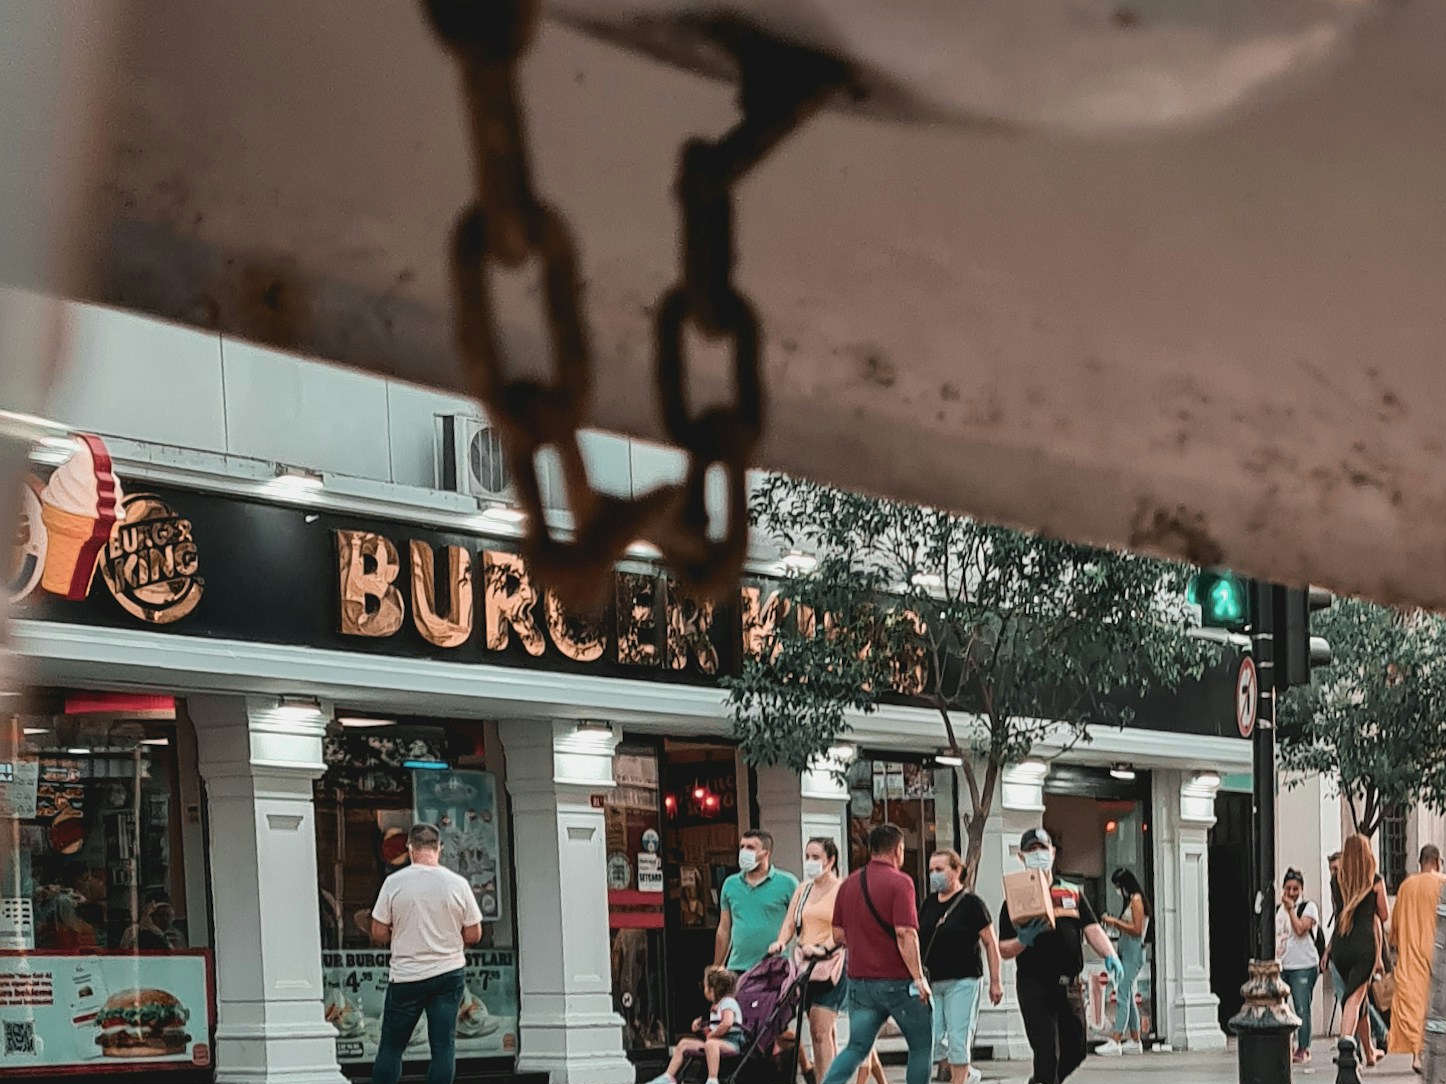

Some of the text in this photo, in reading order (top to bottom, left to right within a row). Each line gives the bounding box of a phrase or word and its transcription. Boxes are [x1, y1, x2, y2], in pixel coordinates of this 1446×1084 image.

[109, 519, 193, 559] BURGER
[114, 542, 198, 593] KING
[465, 952, 512, 967] STLARI
